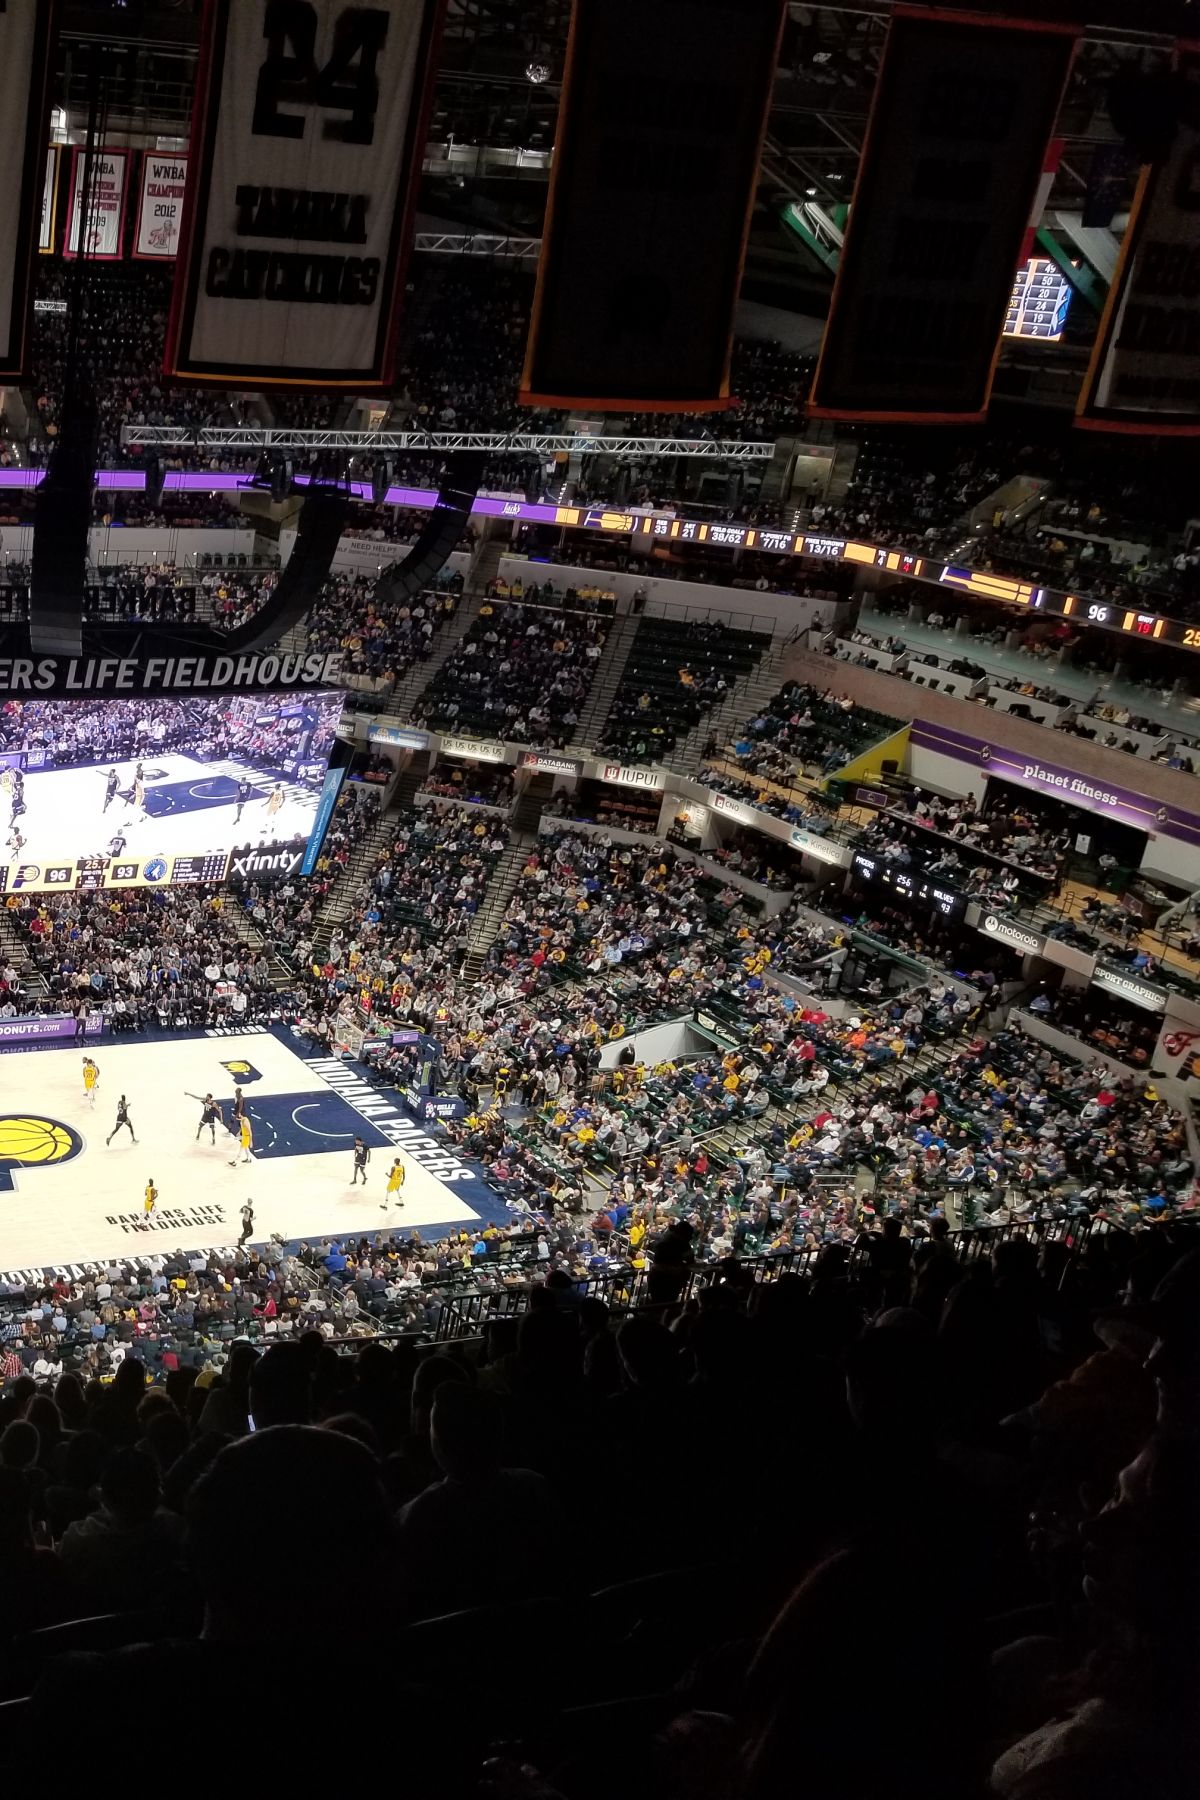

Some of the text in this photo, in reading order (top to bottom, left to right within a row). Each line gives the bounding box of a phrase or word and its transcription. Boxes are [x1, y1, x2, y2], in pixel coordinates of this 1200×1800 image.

[252, 0, 390, 145] 24
[153, 165, 185, 180] WNBA
[154, 204, 177, 218] 2012
[206, 247, 380, 304] CATCHINGS
[1041, 276, 1053, 286] 50
[1038, 289, 1050, 298] 20
[1036, 302, 1047, 311] 24
[1033, 313, 1044, 323] 19
[1032, 326, 1038, 335] 2
[654, 525, 667, 535] 33
[682, 529, 694, 538] 21
[711, 532, 741, 544] 38/62
[763, 538, 787, 549] 7/16
[351, 542, 371, 551] NEED
[809, 544, 838, 556] 13/16
[877, 557, 884, 566] 4
[903, 563, 910, 572] 4
[1088, 605, 1107, 622] 96
[65, 658, 138, 690] LIFE
[142, 653, 344, 689] FIELDHOUSE
[537, 758, 576, 770] DATABANK
[622, 770, 658, 786] IUPUI
[1023, 764, 1118, 806] planet fitness
[725, 801, 740, 812] CNO
[810, 839, 840, 859] Kinetico
[84, 859, 109, 870] 25.7
[230, 849, 303, 876] xfinity
[856, 855, 875, 869] PACERS
[49, 870, 67, 881] 96
[116, 867, 134, 878] 93
[862, 868, 871, 878] 96
[933, 889, 954, 904] WOLVES
[941, 903, 951, 913] 93
[998, 924, 1039, 947] motorola
[1094, 967, 1167, 1006] SPORT GRAPHICS
[303, 1056, 476, 1182] INDIANA PACERS
[189, 1204, 227, 1216] LIFE
